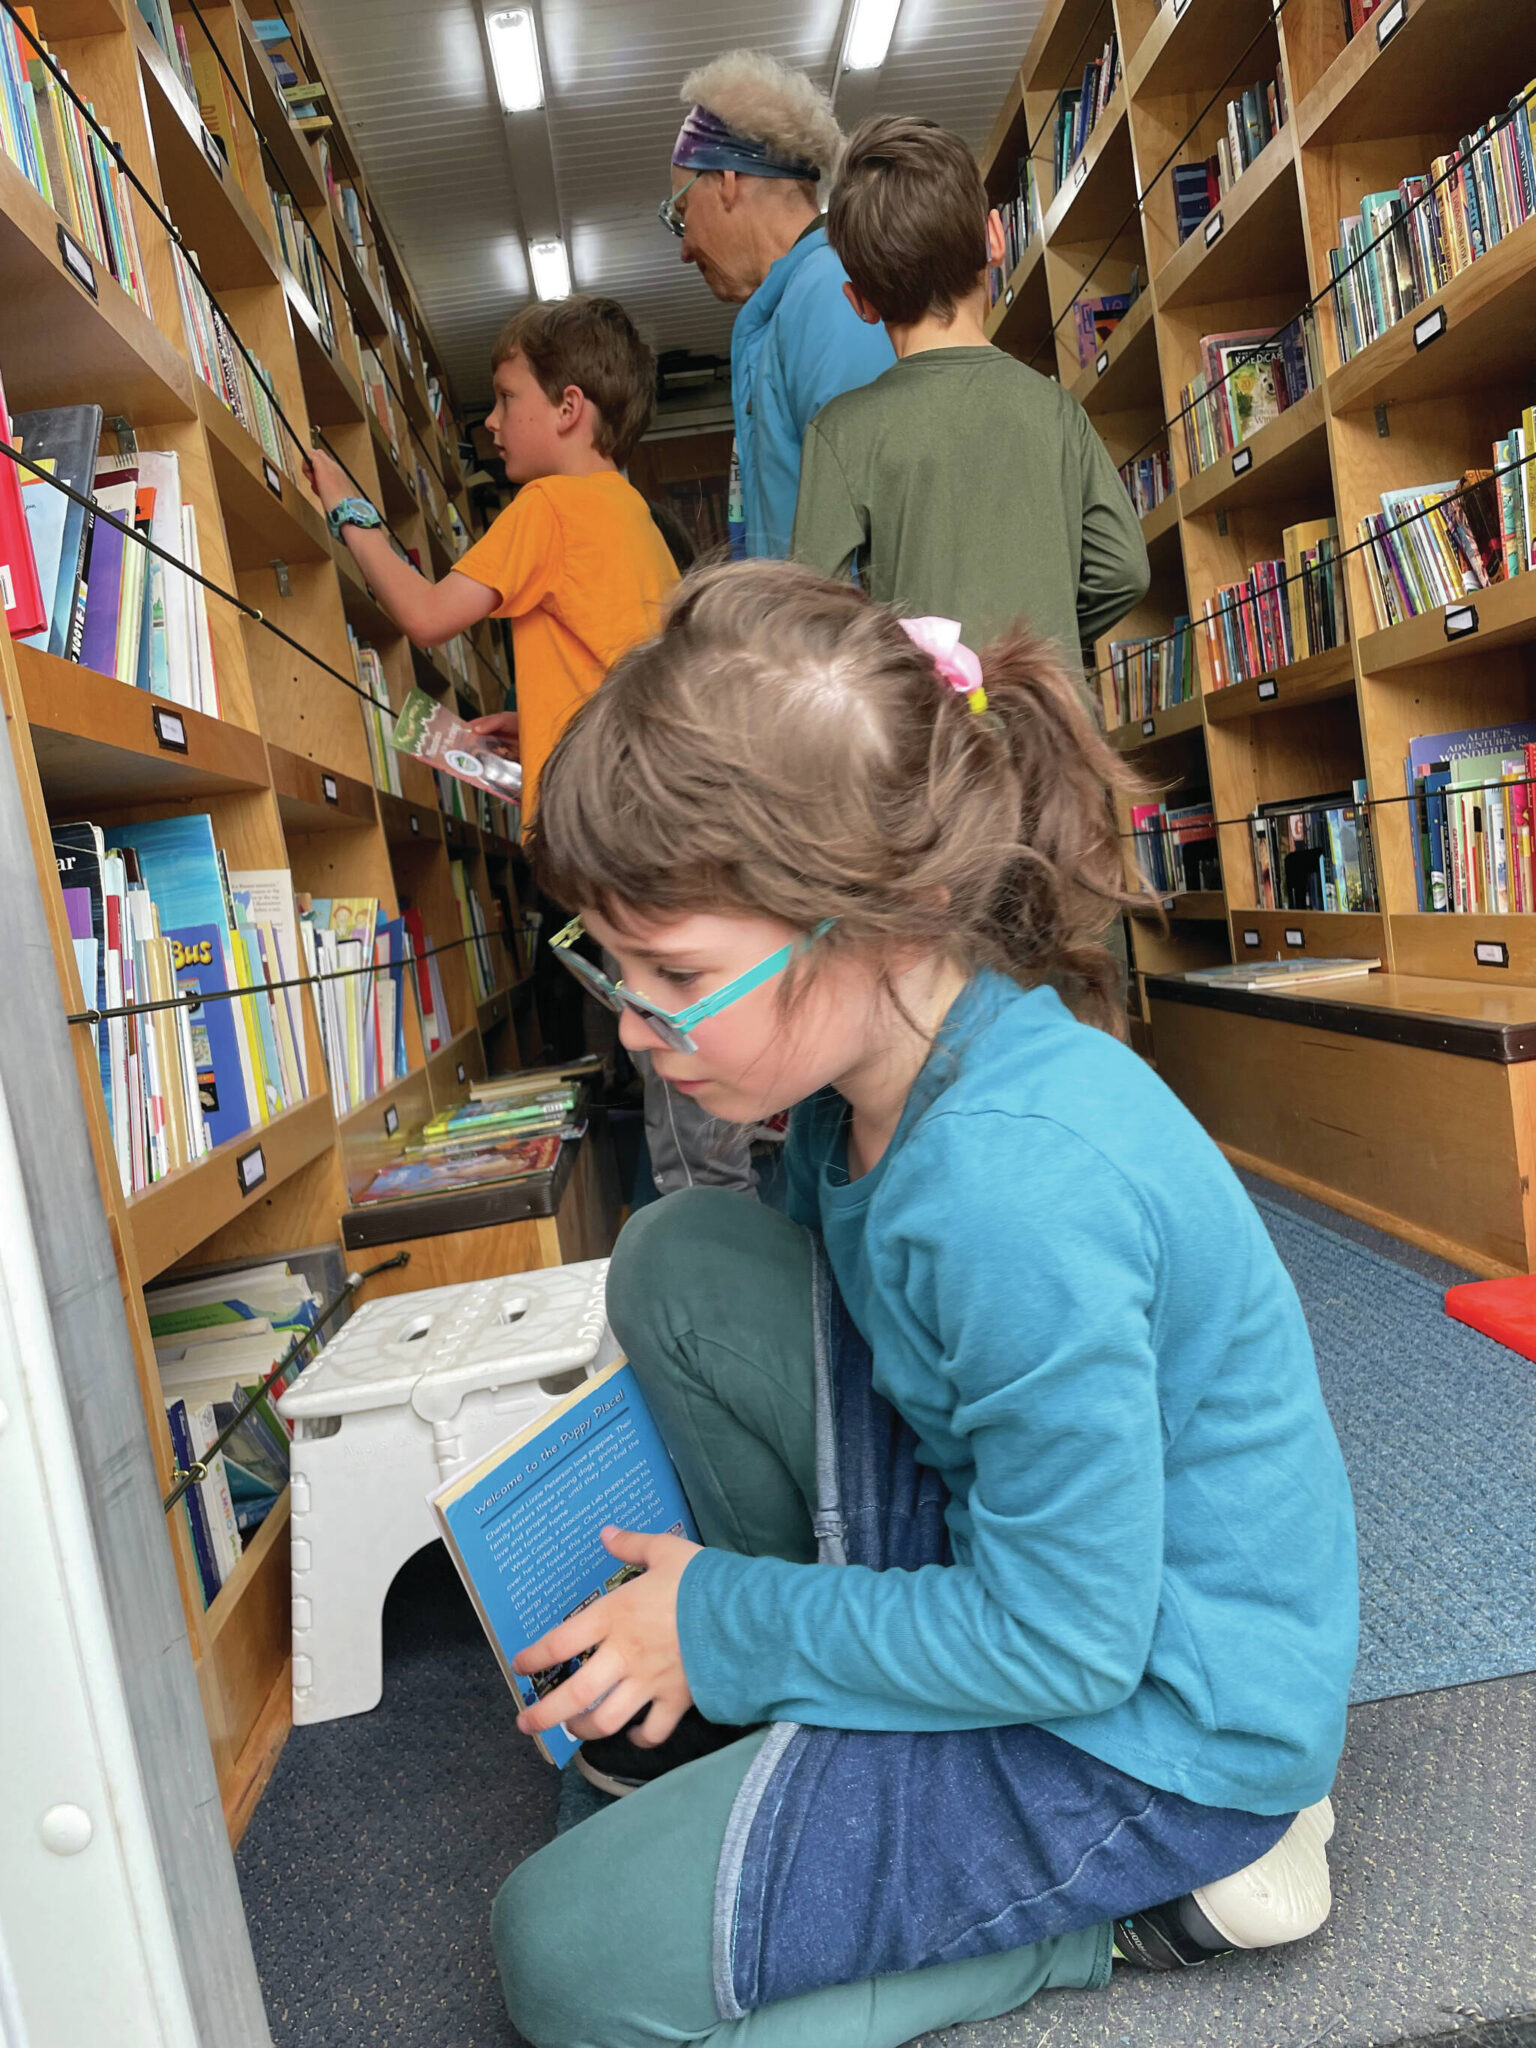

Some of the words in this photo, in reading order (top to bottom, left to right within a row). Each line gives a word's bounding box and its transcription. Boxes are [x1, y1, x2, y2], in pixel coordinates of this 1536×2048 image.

[72, 621, 84, 656] LOOK
[1439, 743, 1524, 762] WONDERLAN
[1447, 736, 1517, 753] ADVENTURES
[1519, 734, 1528, 742] IN
[1468, 728, 1511, 741] ALICE'S
[474, 1474, 523, 1514] Welcome
[526, 1462, 538, 1473] to
[541, 1446, 558, 1460] the
[560, 1418, 591, 1444] Puppy
[593, 1390, 624, 1417] Place!
[486, 1519, 511, 1540] Charles
[525, 1491, 544, 1507] Lizzie
[544, 1467, 574, 1491] Peterson
[573, 1455, 588, 1467] love
[616, 1419, 632, 1432] Their
[490, 1533, 511, 1550] family
[512, 1512, 536, 1531] fosters
[537, 1495, 555, 1511] these
[557, 1476, 578, 1496] young
[598, 1444, 619, 1462] giving
[619, 1430, 637, 1444] them
[494, 1547, 509, 1561] love
[526, 1513, 548, 1536] proper
[569, 1483, 583, 1498] until
[585, 1472, 599, 1484] they
[499, 1548, 523, 1573] perfect
[524, 1526, 548, 1548] forever
[507, 1576, 521, 1590] over
[536, 1544, 559, 1564] elderly
[584, 1504, 609, 1524] Charles
[610, 1477, 641, 1504] convinces
[512, 1555, 531, 1572] When
[561, 1505, 591, 1531] chocolate
[519, 1598, 542, 1620] energy
[544, 1566, 577, 1596] behavior?
[648, 1498, 661, 1509] that
[527, 1572, 557, 1599] Peterson
[557, 1542, 592, 1572] household
[616, 1502, 641, 1523] Cocoa's
[511, 1577, 536, 1602] parents
[547, 1551, 566, 1568] foster
[569, 1539, 581, 1550] this
[523, 1618, 536, 1629] this
[552, 1591, 563, 1603] will
[564, 1577, 582, 1592] learn
[638, 1519, 652, 1529] they
